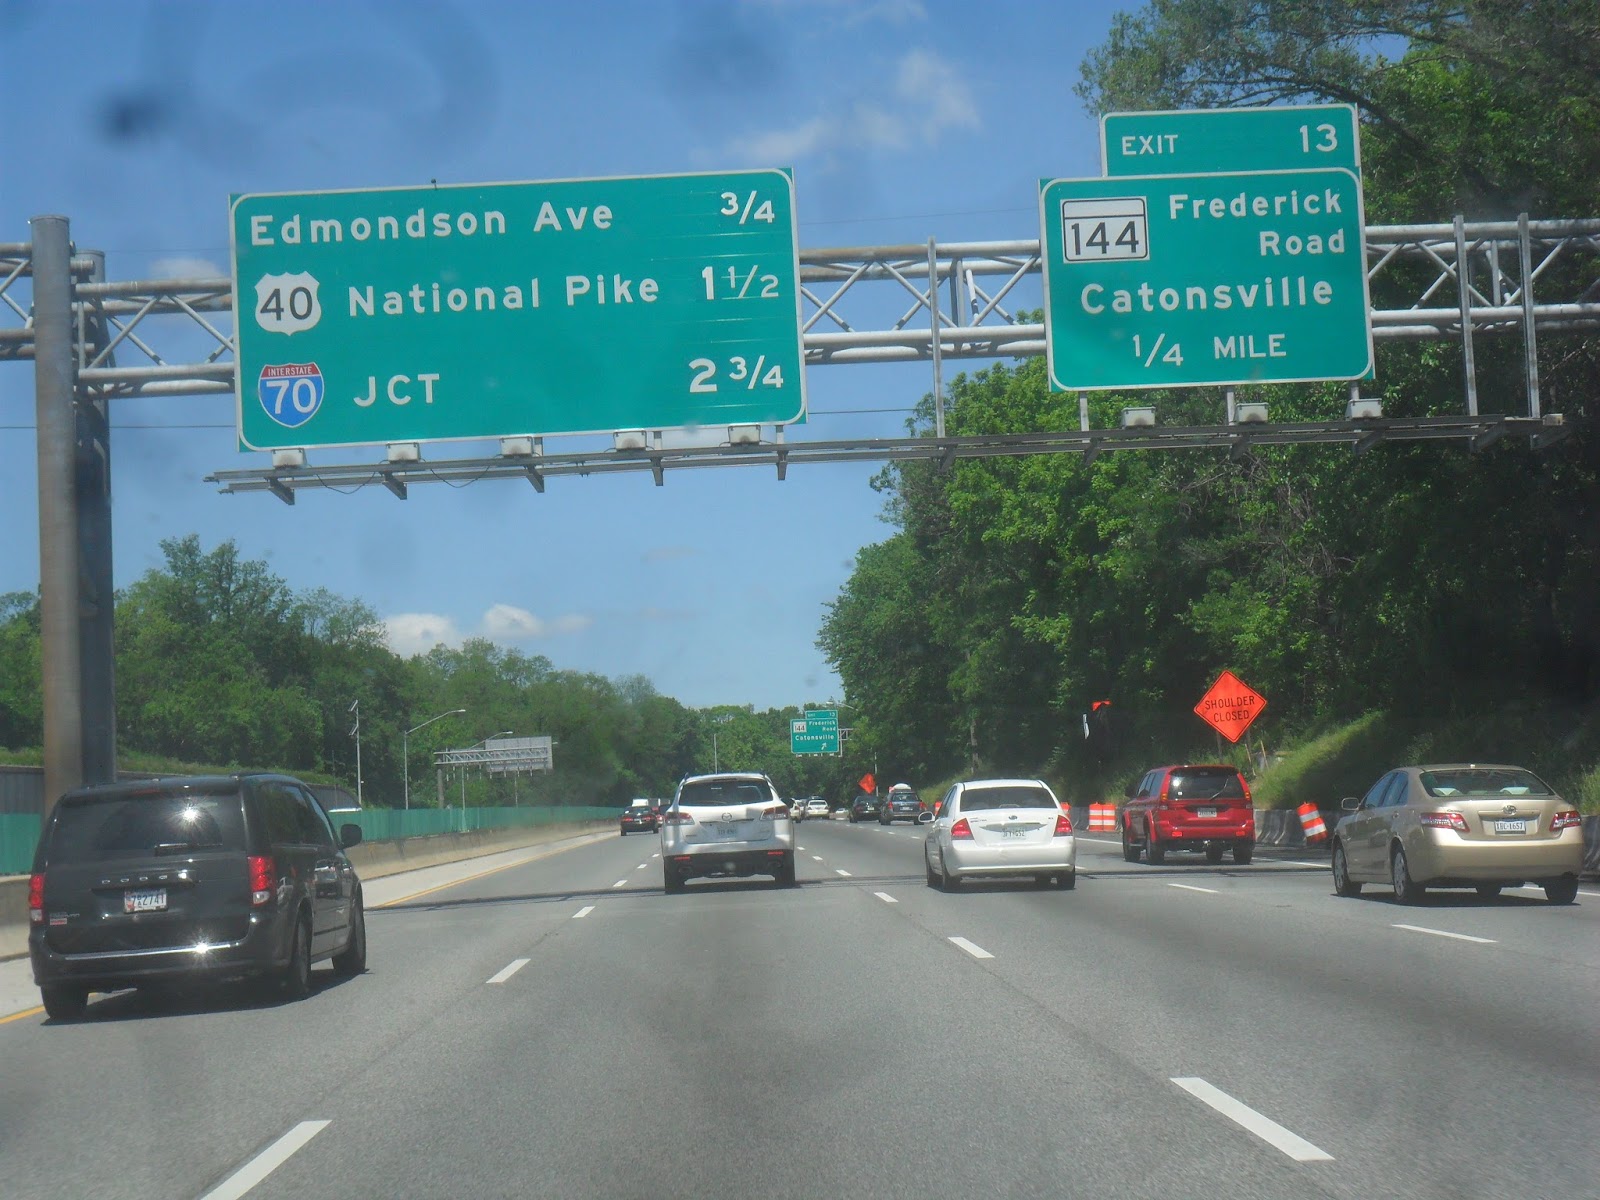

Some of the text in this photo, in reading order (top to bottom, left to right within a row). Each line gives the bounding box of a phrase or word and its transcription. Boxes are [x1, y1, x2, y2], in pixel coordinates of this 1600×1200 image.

[1121, 123, 1338, 156] EXIT 13
[250, 190, 776, 246] Edmondson Ave 3/4
[1169, 188, 1342, 220] Frederick
[1071, 220, 1140, 256] 144
[1259, 228, 1345, 257] Road
[259, 286, 314, 322] 40
[348, 277, 540, 317] National
[565, 273, 659, 306] Pike
[701, 266, 715, 301] 1
[1080, 275, 1333, 315] Catonsville
[1132, 333, 1287, 368] 1/4 MILE
[267, 366, 313, 377] INTERSTATE
[353, 373, 440, 408] JCT
[688, 357, 718, 393] 2
[266, 378, 317, 415] 70
[1205, 696, 1255, 710] SHOULDER
[1213, 710, 1249, 723] CLOSED
